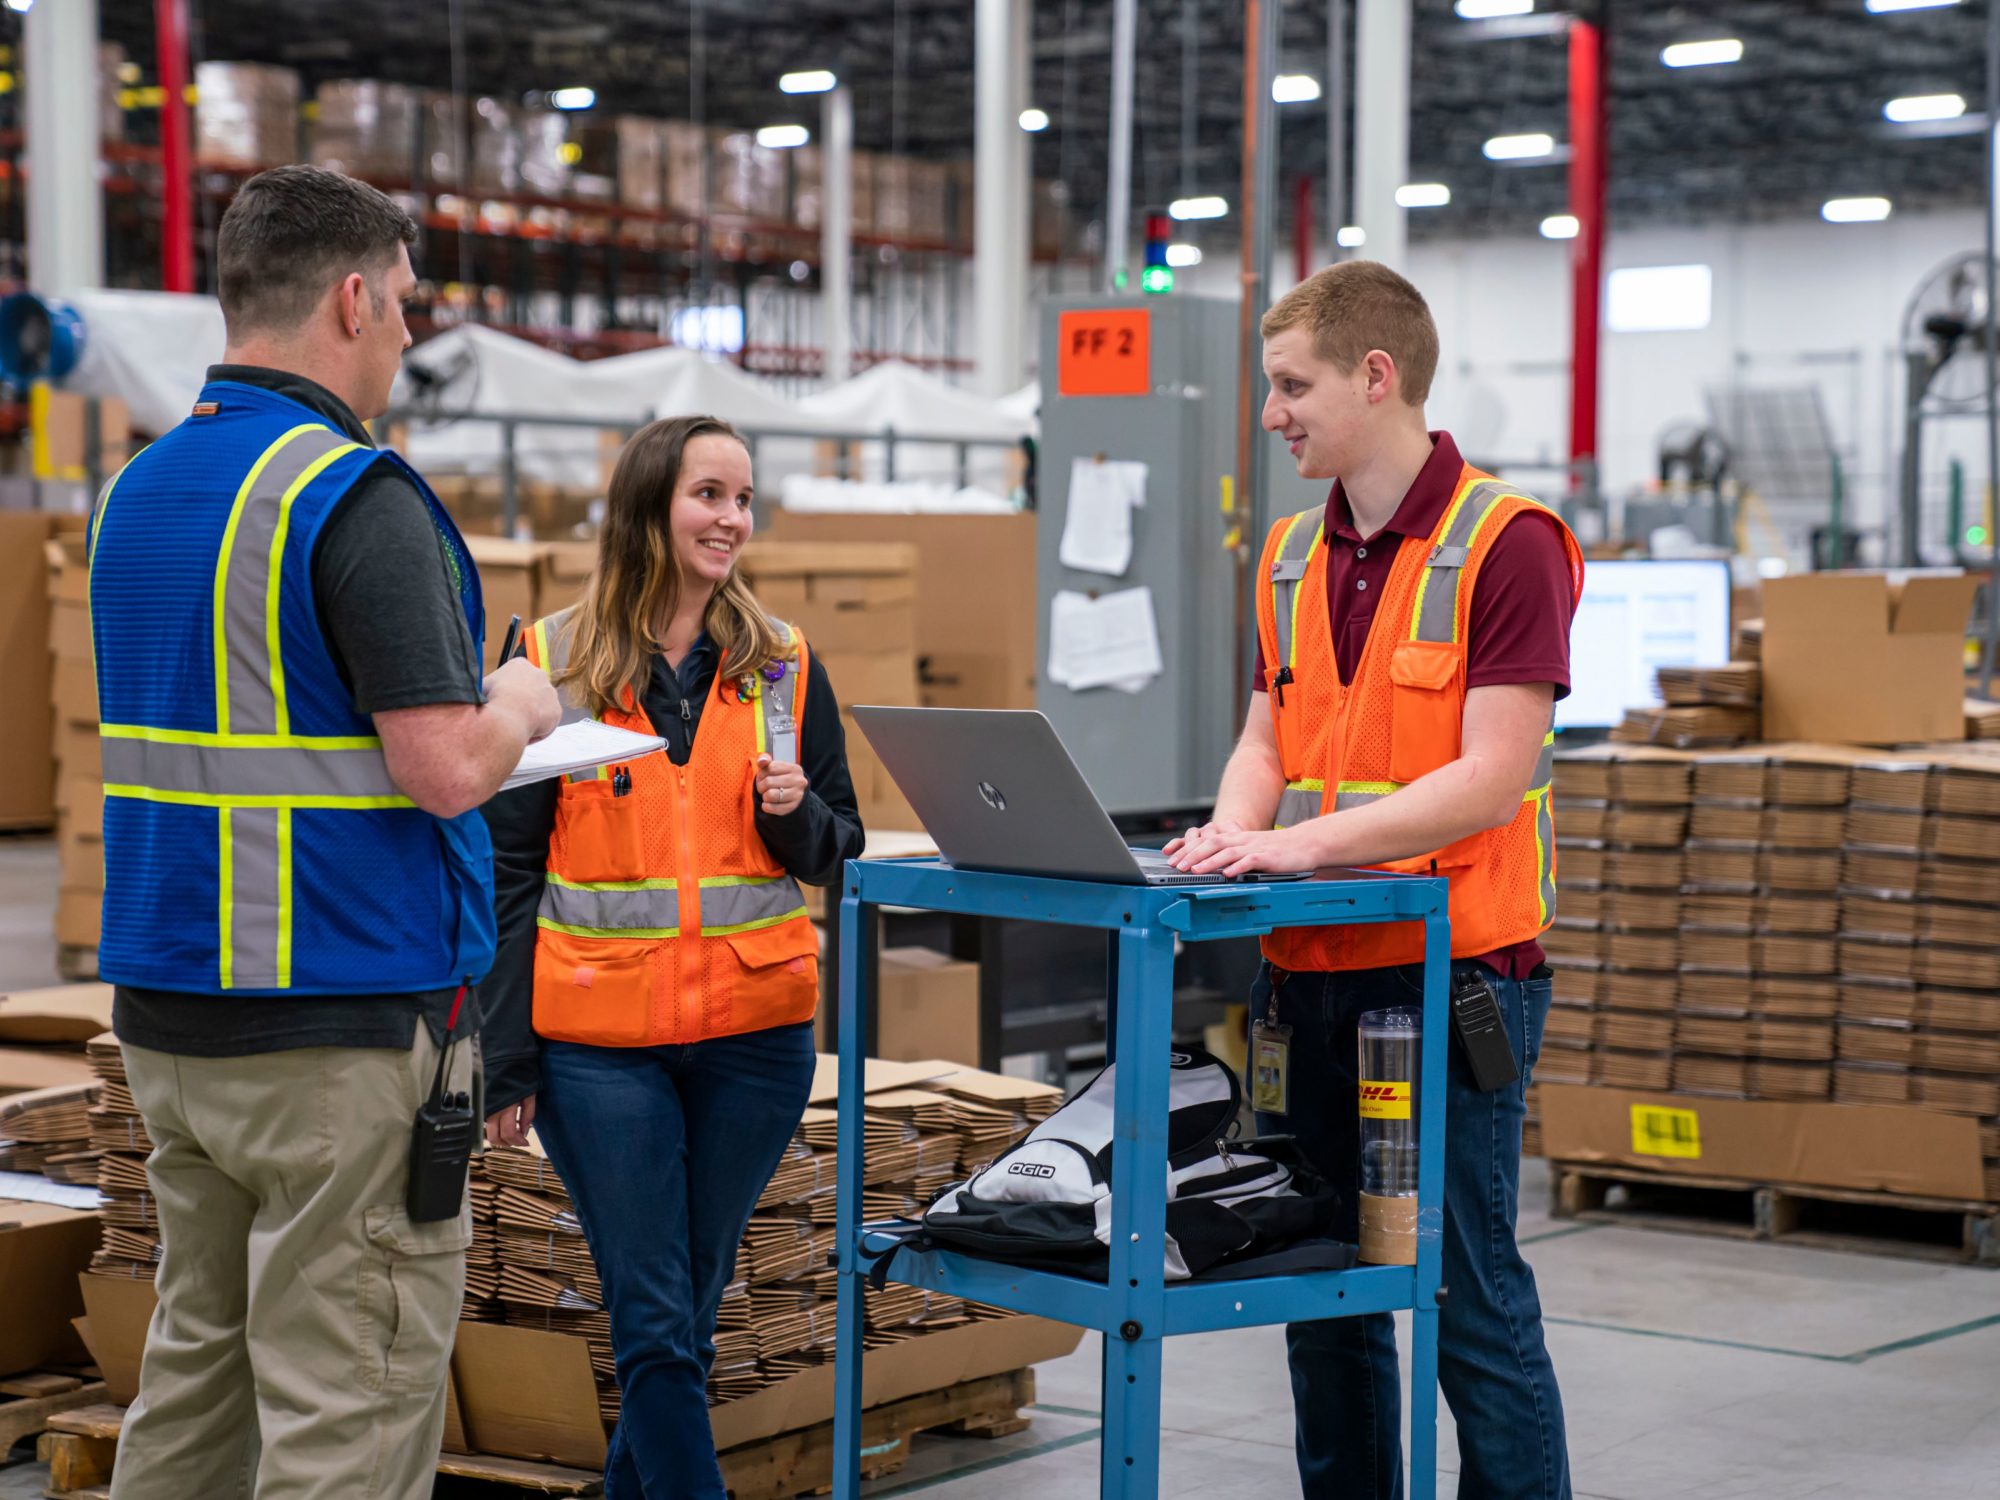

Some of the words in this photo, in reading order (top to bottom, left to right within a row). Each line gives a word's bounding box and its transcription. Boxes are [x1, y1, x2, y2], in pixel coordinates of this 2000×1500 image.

[1072, 328, 1107, 357] FF
[1118, 327, 1134, 357] 2
[1008, 1162, 1056, 1179] OGIO
